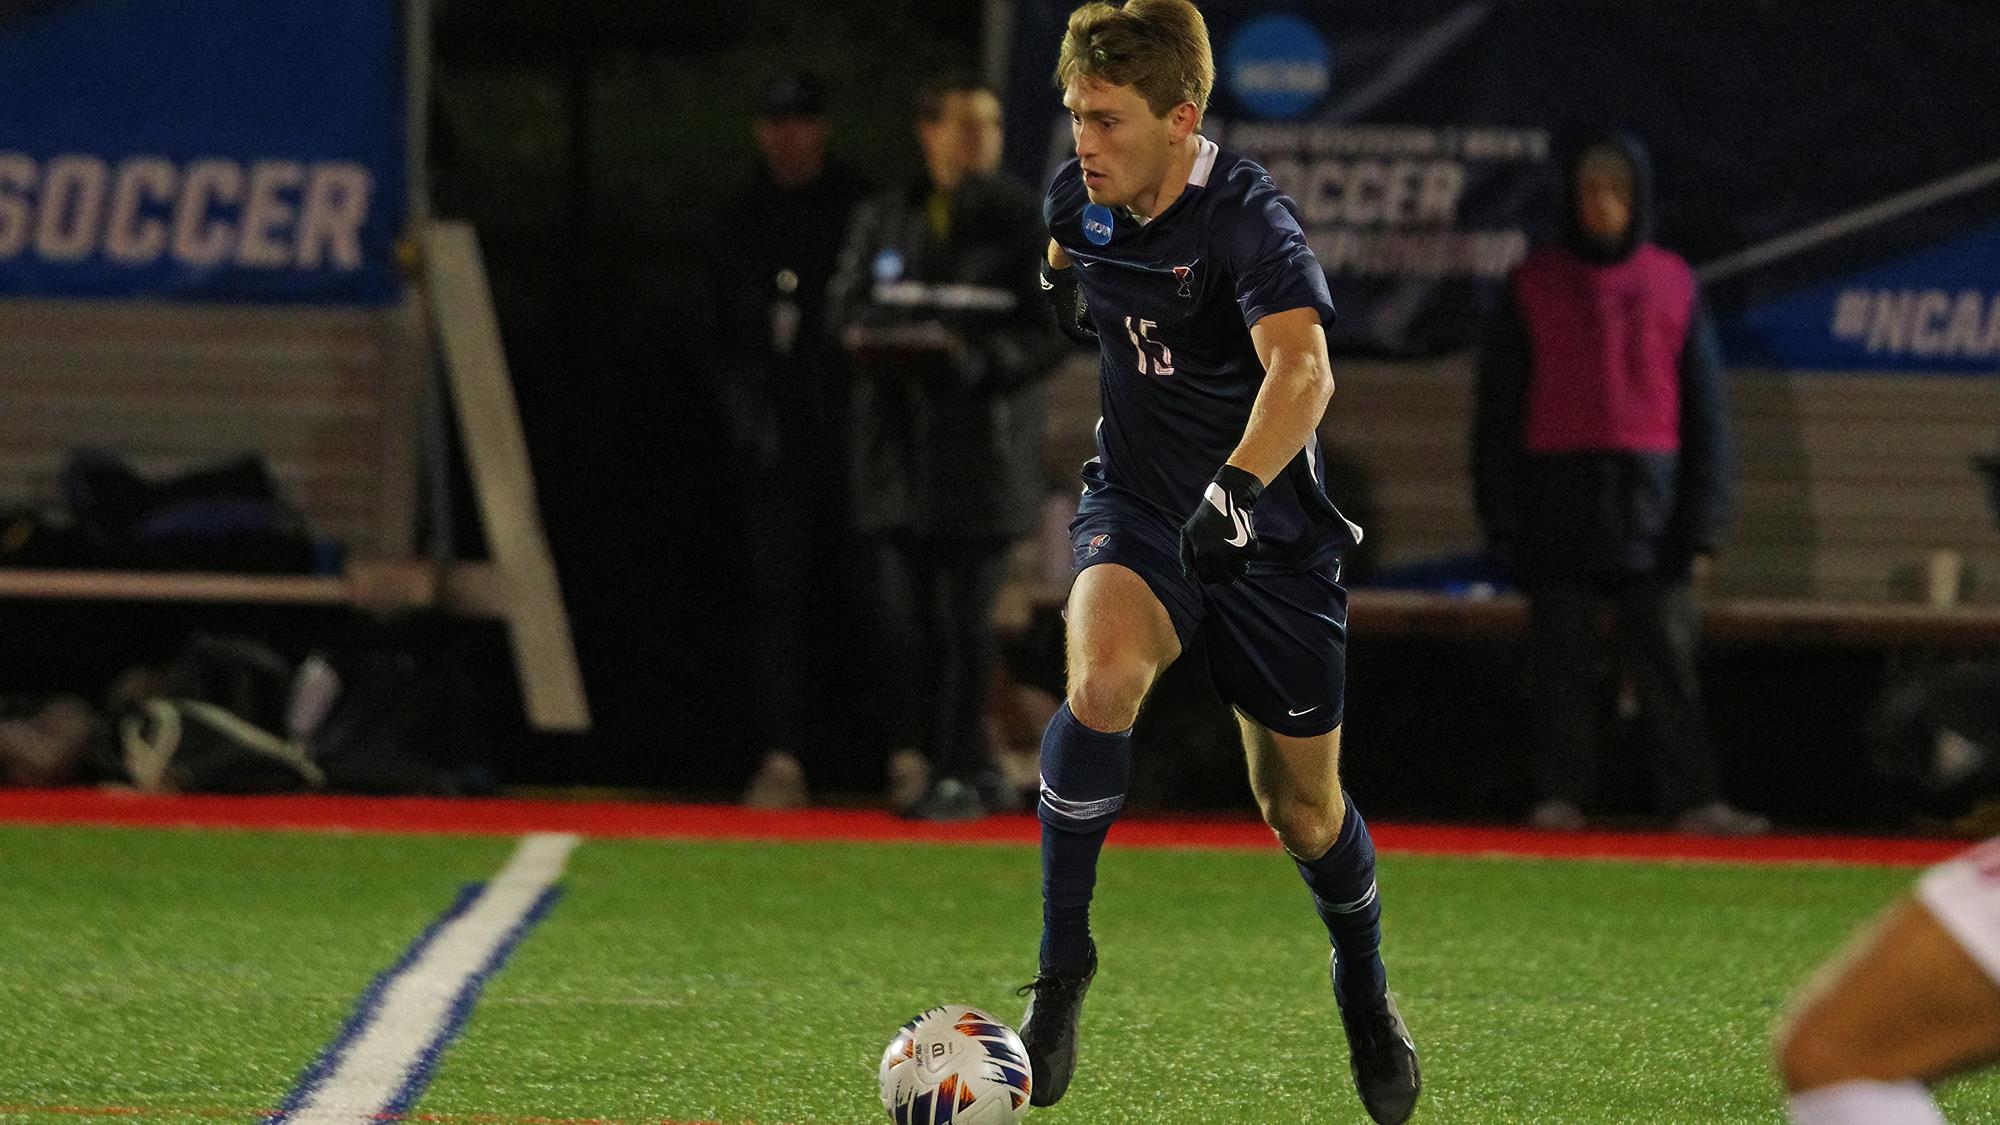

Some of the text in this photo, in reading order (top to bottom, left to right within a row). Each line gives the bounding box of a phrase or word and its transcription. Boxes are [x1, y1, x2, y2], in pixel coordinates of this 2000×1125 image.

[0, 153, 372, 268] SOCCER
[1266, 160, 1463, 224] OCCER
[1123, 313, 1175, 377] 15
